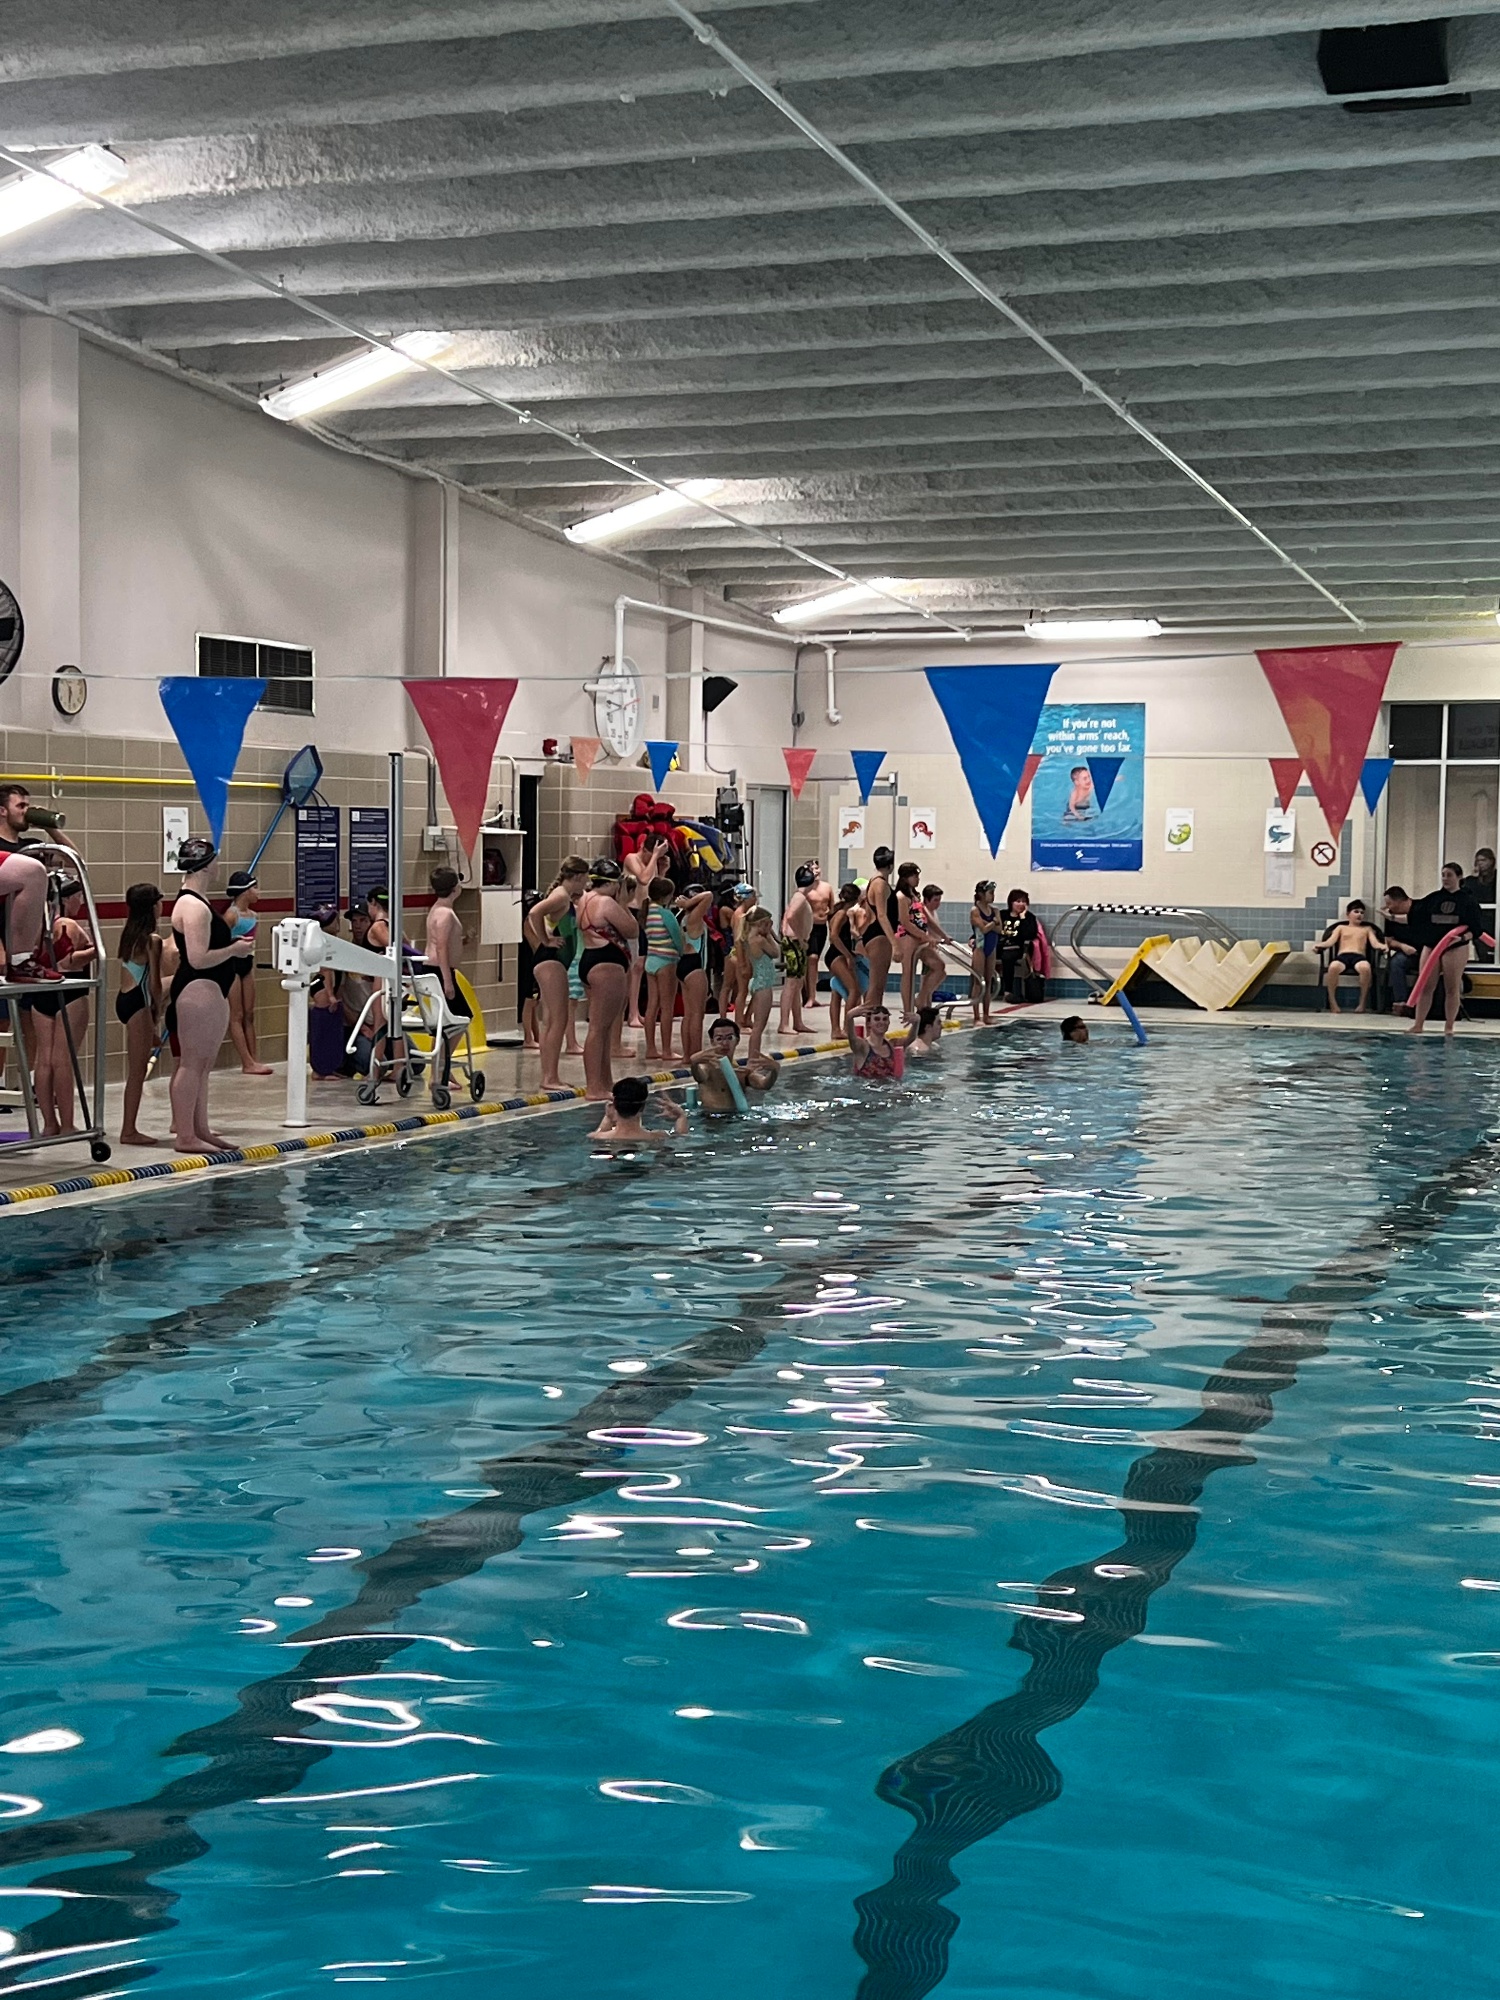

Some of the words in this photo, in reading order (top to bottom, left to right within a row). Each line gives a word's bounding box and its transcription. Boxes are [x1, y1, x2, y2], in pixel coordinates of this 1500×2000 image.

[1062, 718, 1070, 729] If
[1071, 717, 1099, 731] you're
[1101, 718, 1116, 729] not
[1048, 730, 1075, 741] within
[1077, 729, 1101, 741] arms'
[1103, 729, 1130, 742] reach,
[1046, 742, 1074, 755] you've
[1076, 745, 1099, 755] gone
[1100, 743, 1116, 753] too
[1118, 741, 1132, 753] far.
